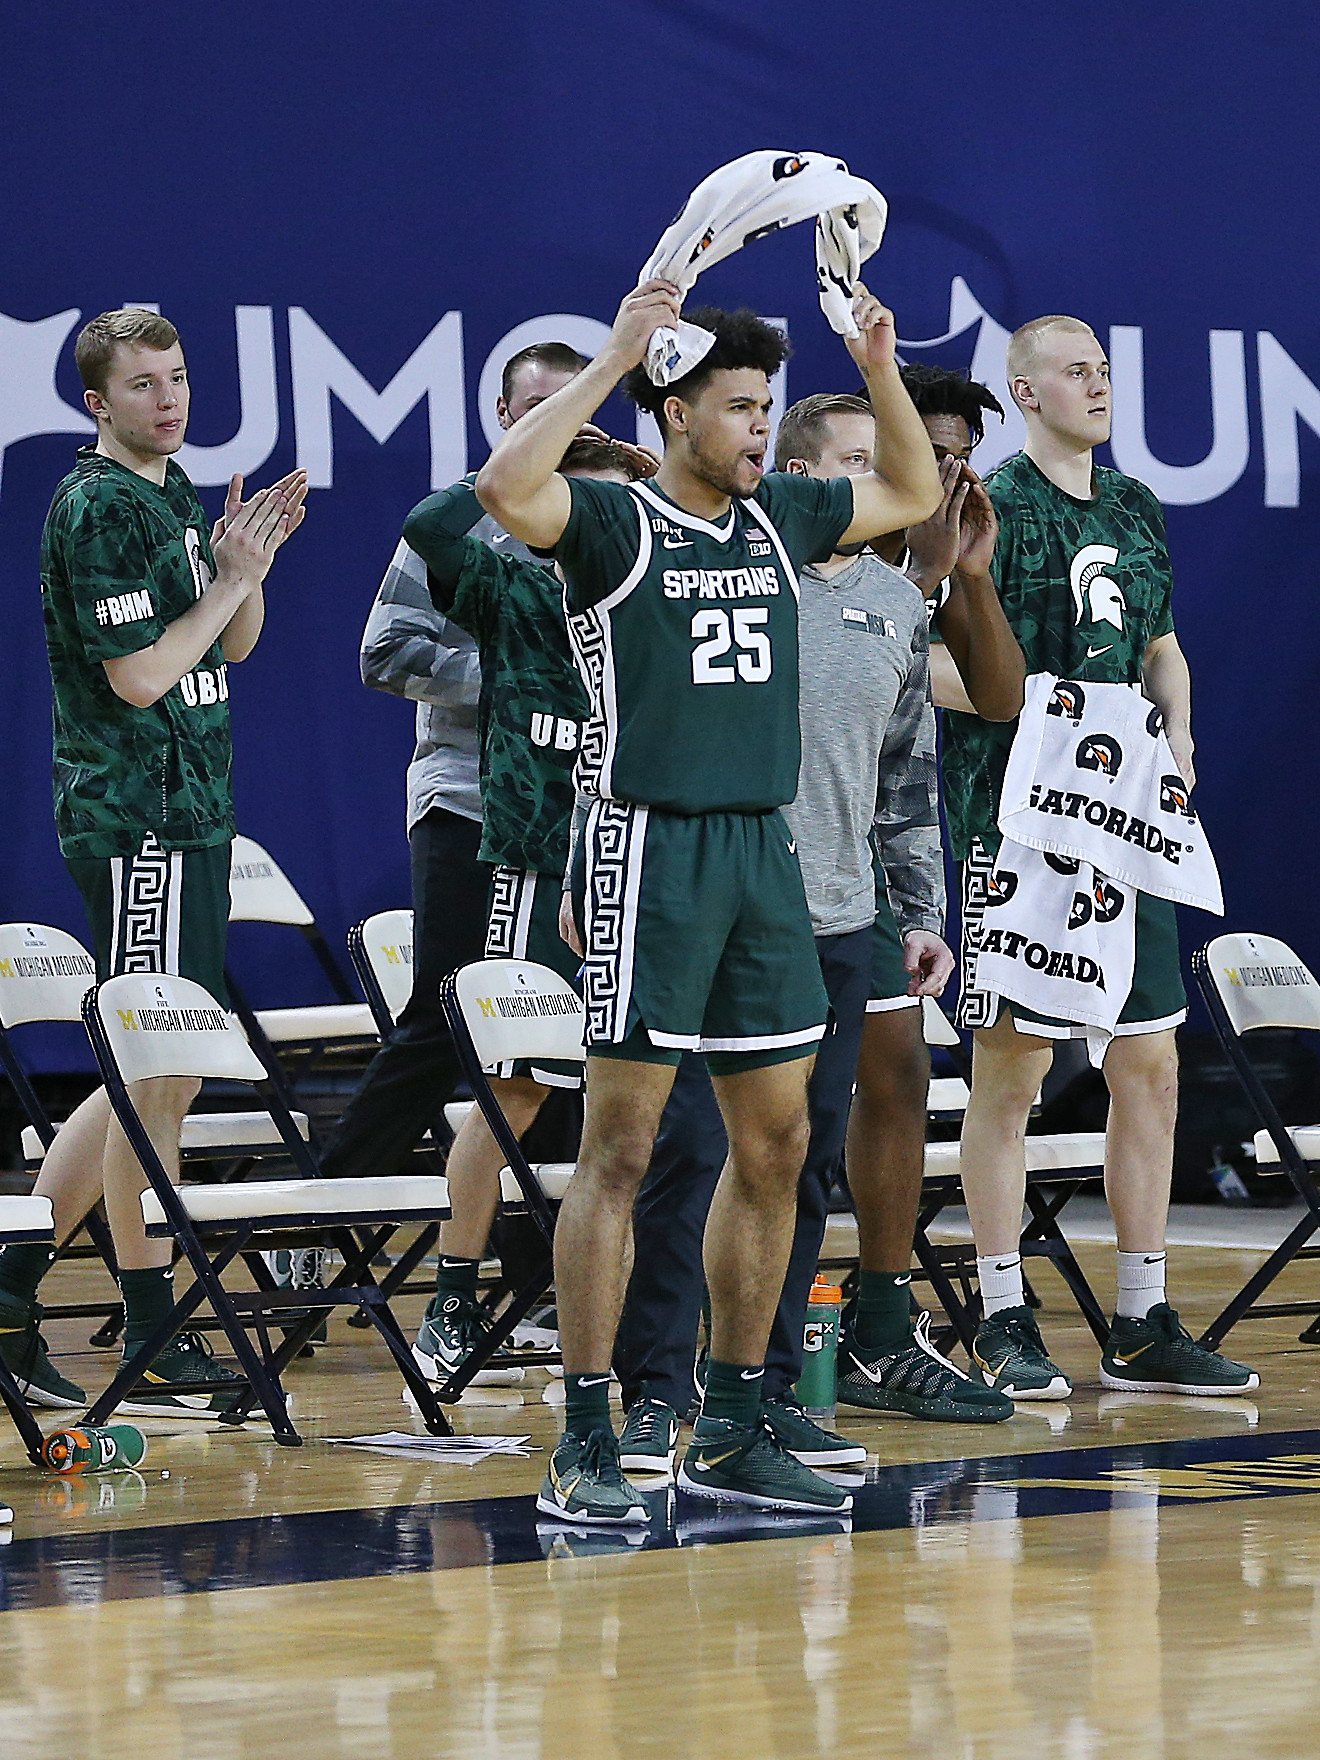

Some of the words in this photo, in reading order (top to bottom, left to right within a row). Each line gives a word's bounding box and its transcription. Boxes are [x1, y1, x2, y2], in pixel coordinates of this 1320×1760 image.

[662, 566, 780, 599] SPARTANS
[95, 588, 155, 626] #BHM
[691, 607, 772, 685] 25
[51, 954, 96, 976] MEDICINE
[495, 996, 538, 1018] MICHIGAN
[535, 993, 582, 1016] MEDICINE
[137, 1009, 183, 1032] MICHIGAN
[180, 1009, 230, 1031] MEDICINE
